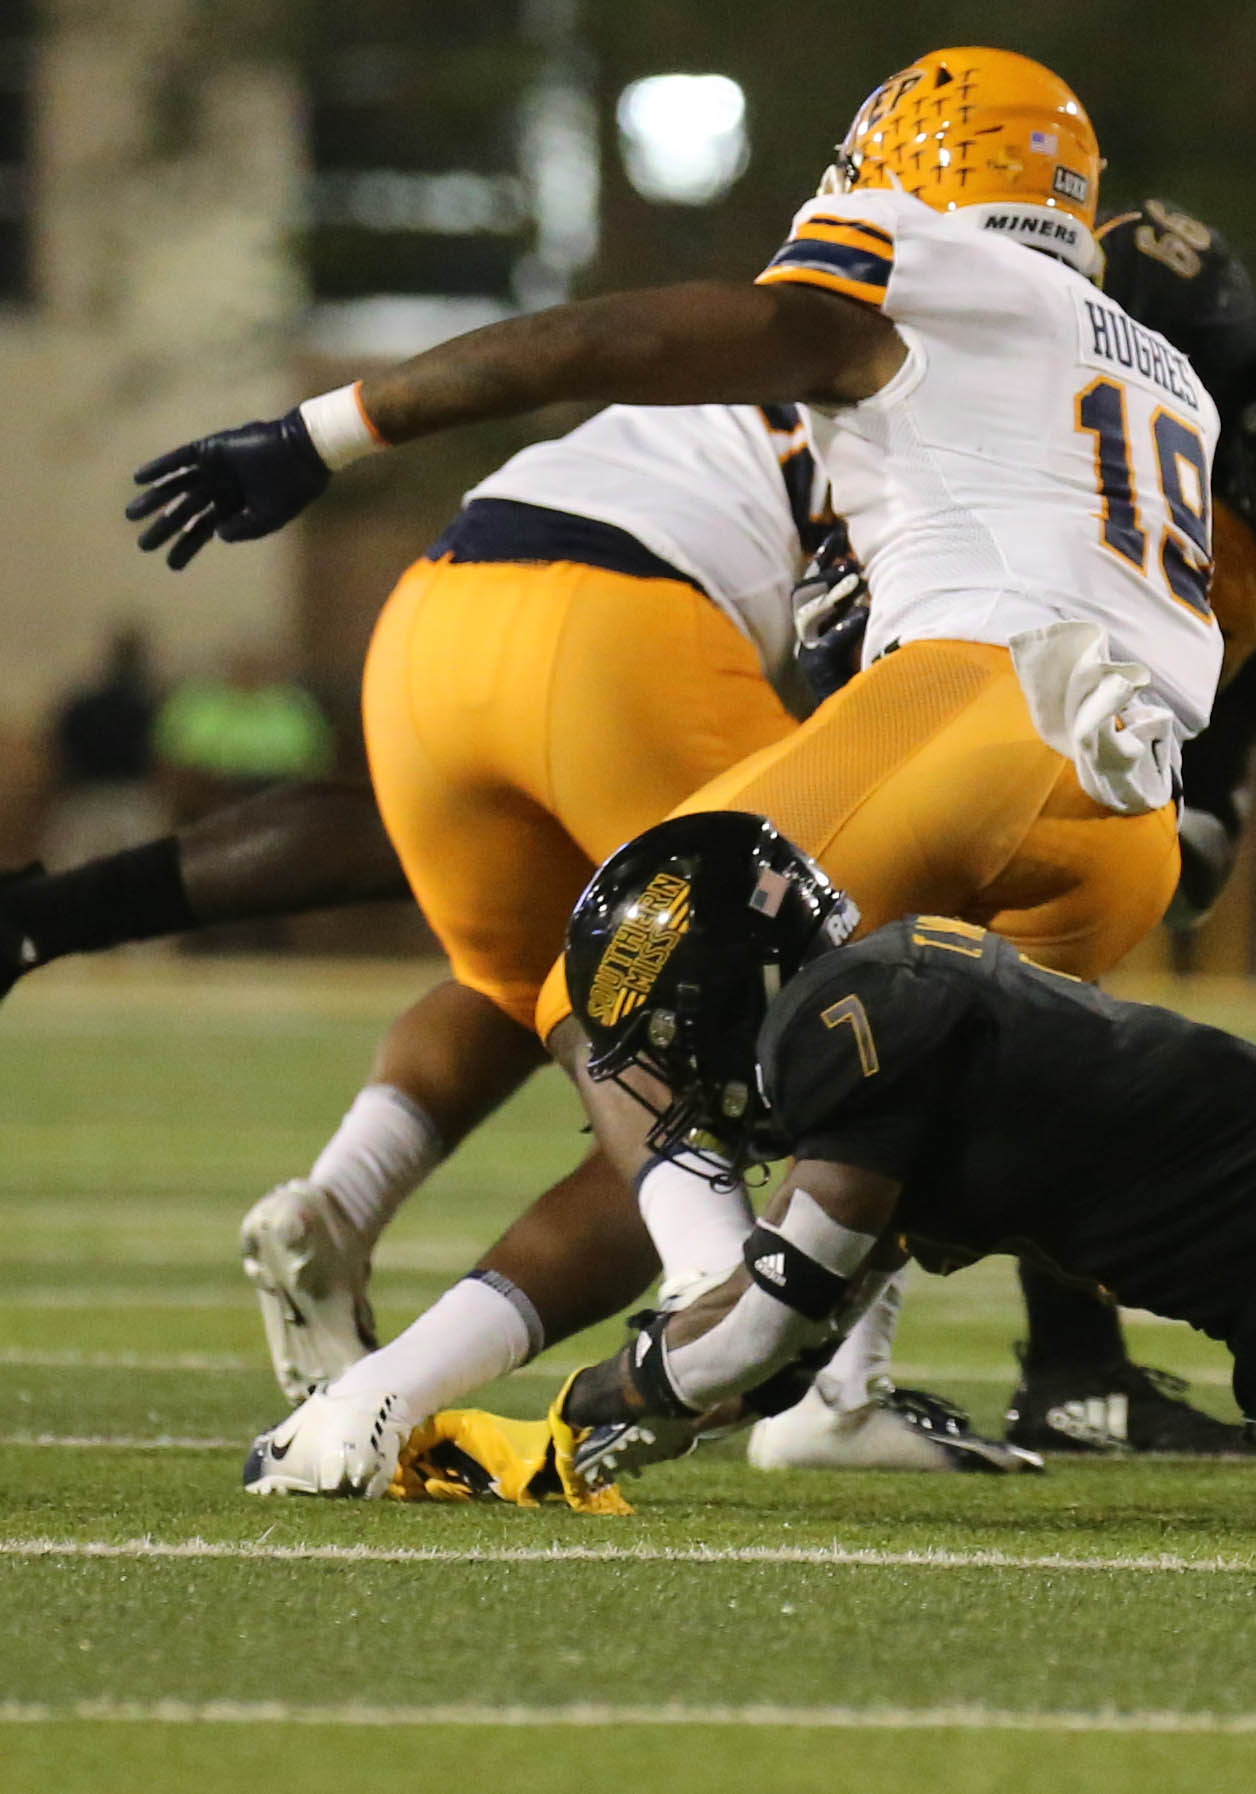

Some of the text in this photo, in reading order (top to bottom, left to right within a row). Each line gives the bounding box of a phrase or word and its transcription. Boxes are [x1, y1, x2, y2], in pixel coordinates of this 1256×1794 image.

[984, 215, 1078, 245] MINERS
[1084, 300, 1199, 410] HUGHES
[1074, 374, 1215, 627] 19
[588, 873, 691, 1025] SOUTHERN
[623, 915, 681, 993] MISS
[820, 994, 879, 1078] 7
